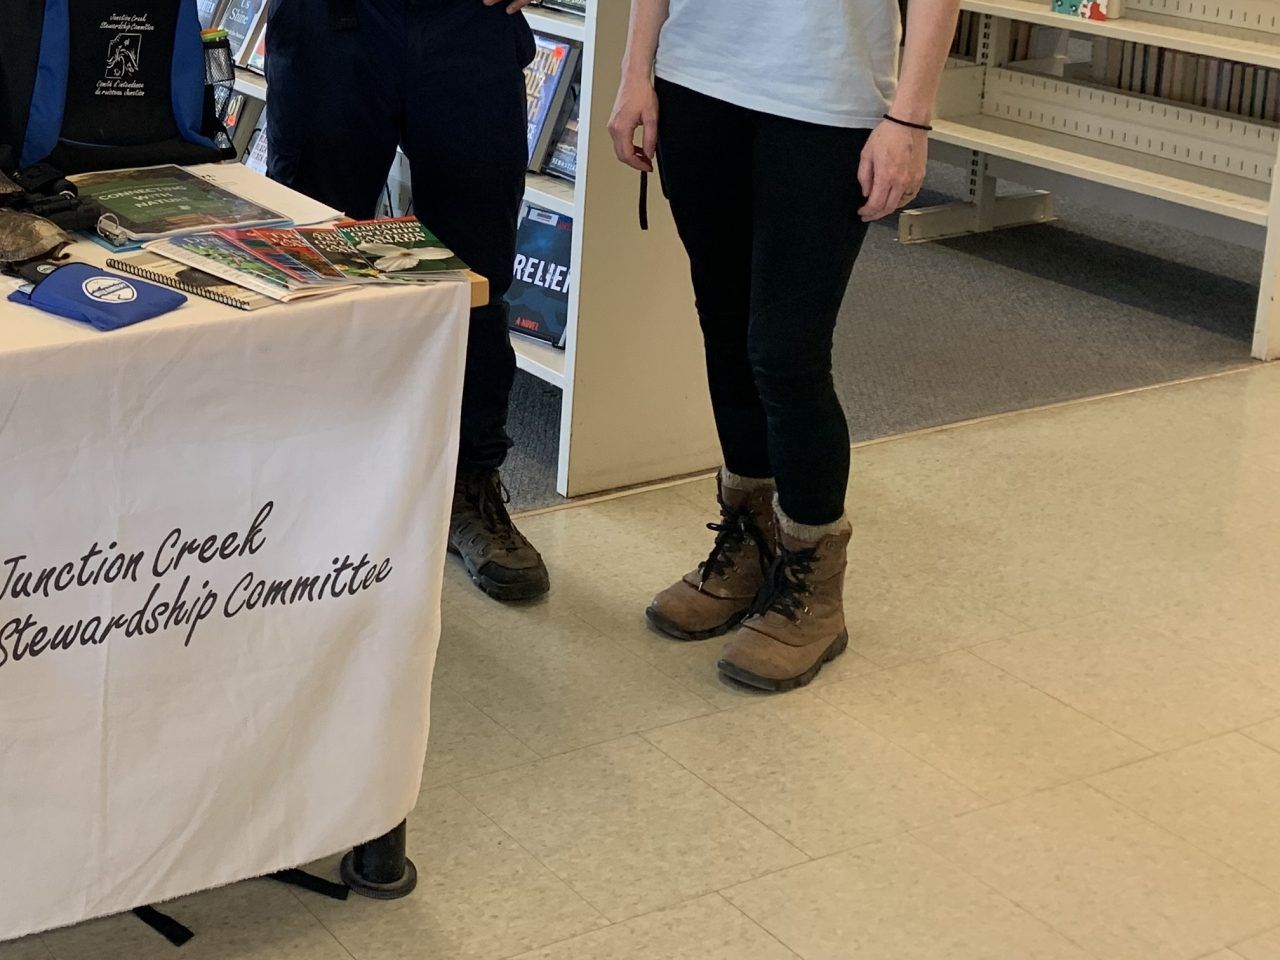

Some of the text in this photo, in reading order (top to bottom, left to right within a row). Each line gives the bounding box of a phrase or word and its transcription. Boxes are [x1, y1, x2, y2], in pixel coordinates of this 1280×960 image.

[229, 8, 249, 25] Shine
[98, 185, 188, 201] CONNECTING
[133, 192, 173, 201] WITH
[135, 196, 189, 209] NATURE
[152, 501, 274, 578] Creek
[223, 553, 393, 619] Committee
